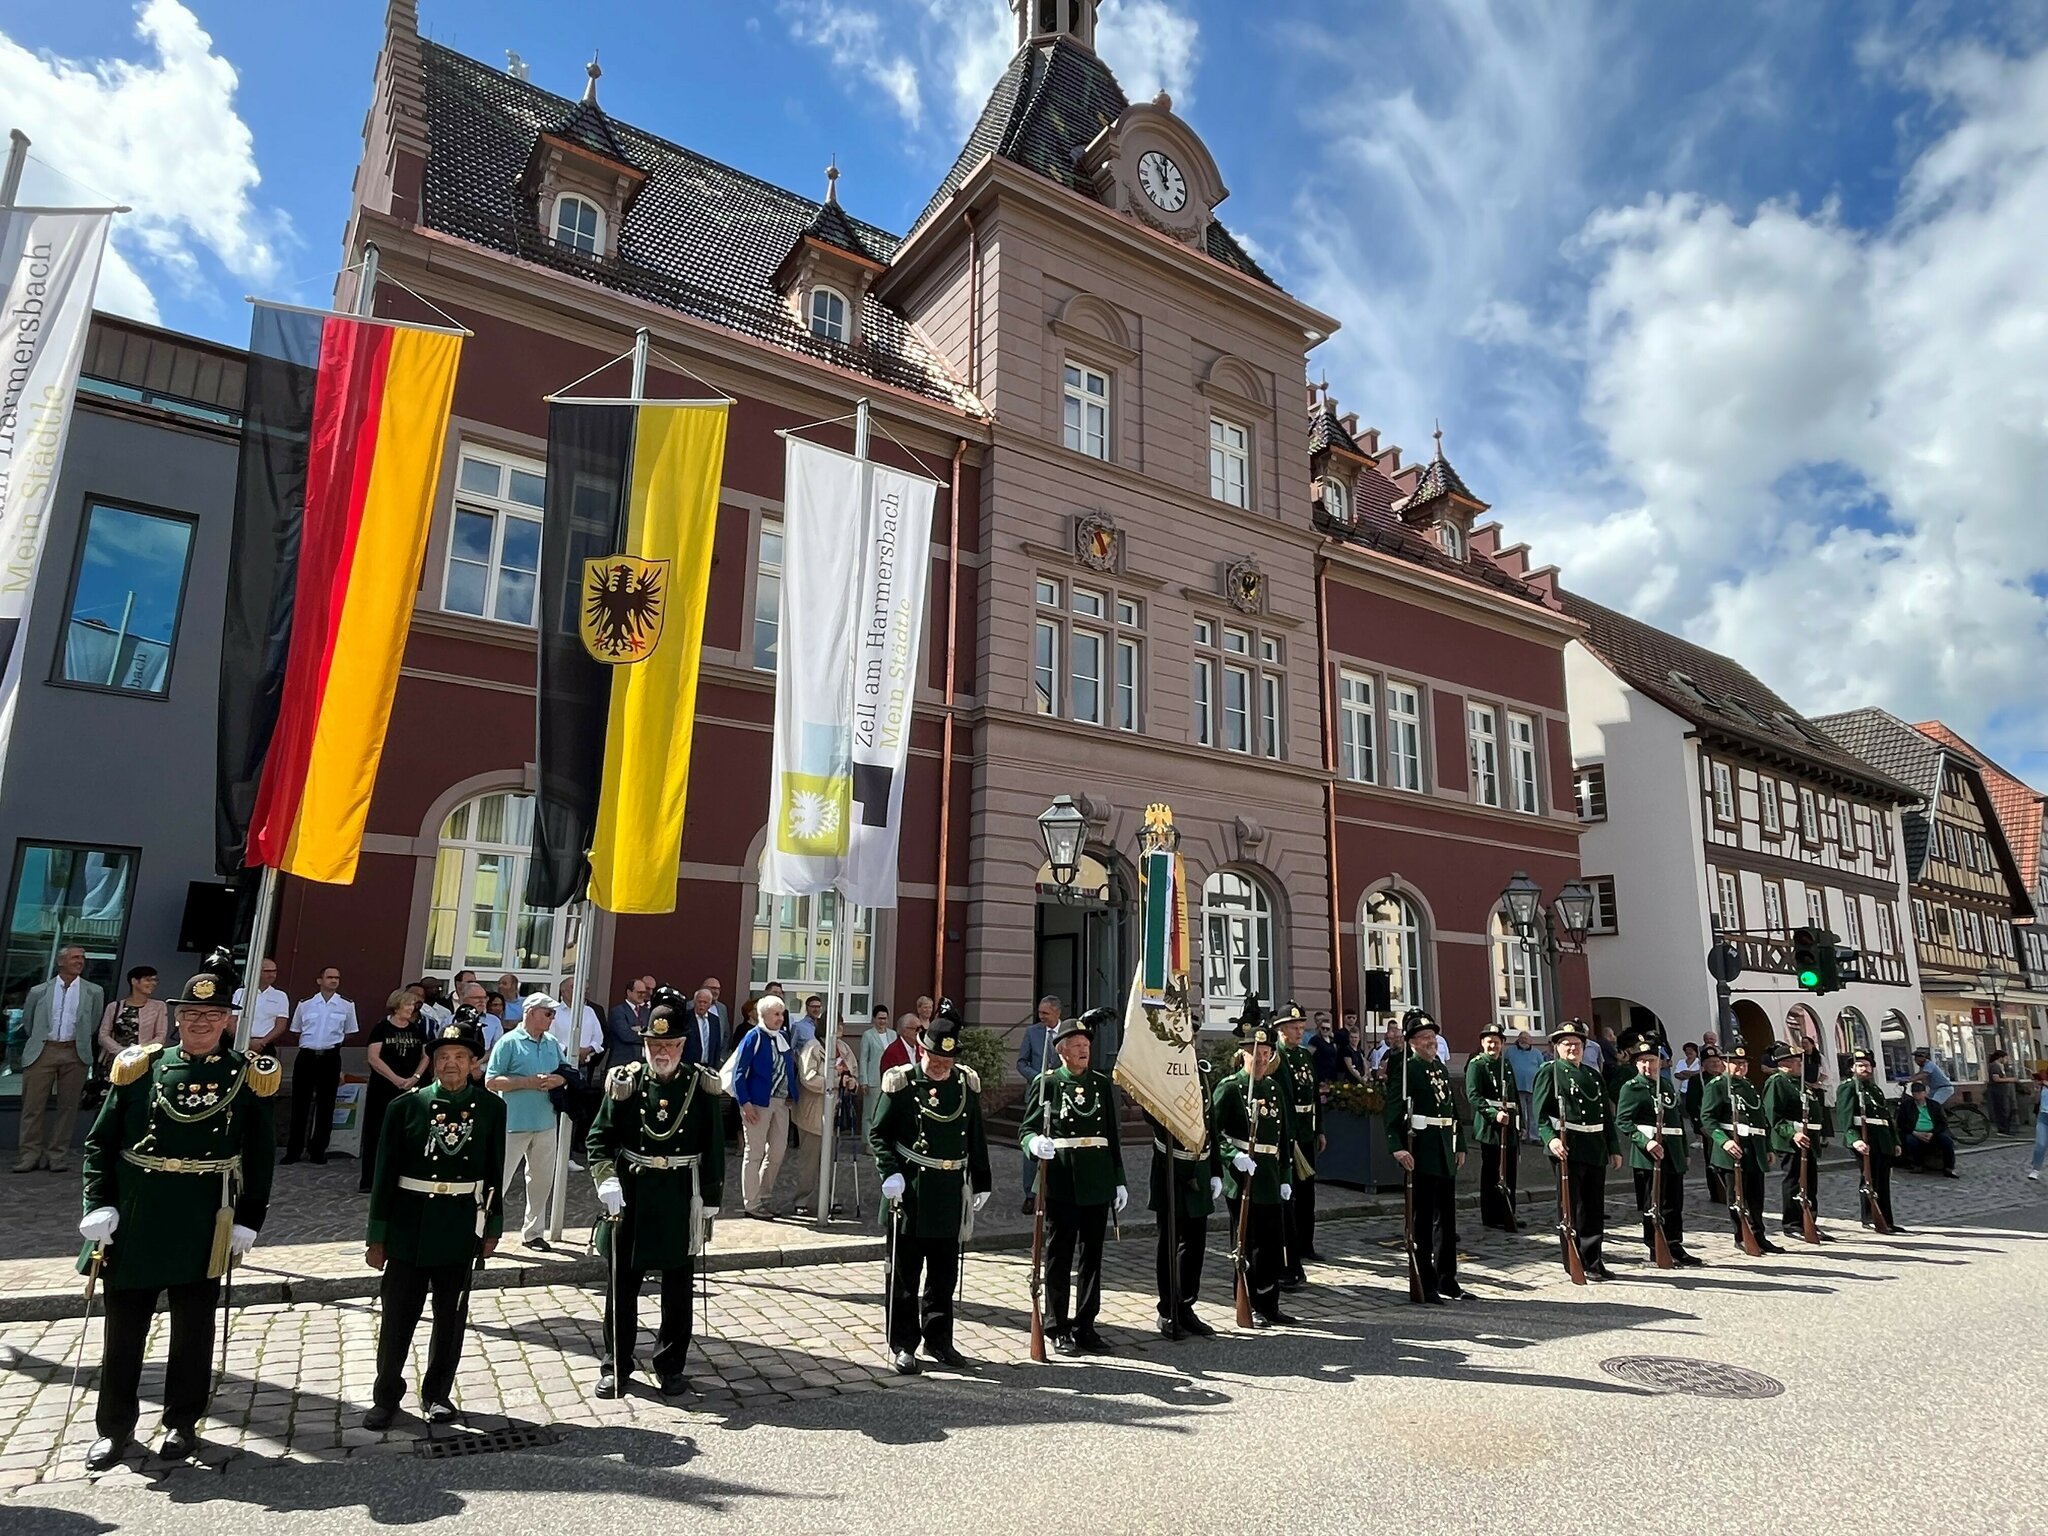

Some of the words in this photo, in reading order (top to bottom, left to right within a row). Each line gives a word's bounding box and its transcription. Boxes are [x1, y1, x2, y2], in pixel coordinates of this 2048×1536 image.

[2, 512, 40, 595] Mein
[21, 383, 65, 500] Städtle
[866, 492, 900, 650] Harmersbach
[888, 598, 911, 679] Städtle
[865, 658, 883, 695] am
[855, 702, 877, 748] Zell
[879, 688, 905, 749] Mein
[1166, 1061, 1190, 1076] ZELL
